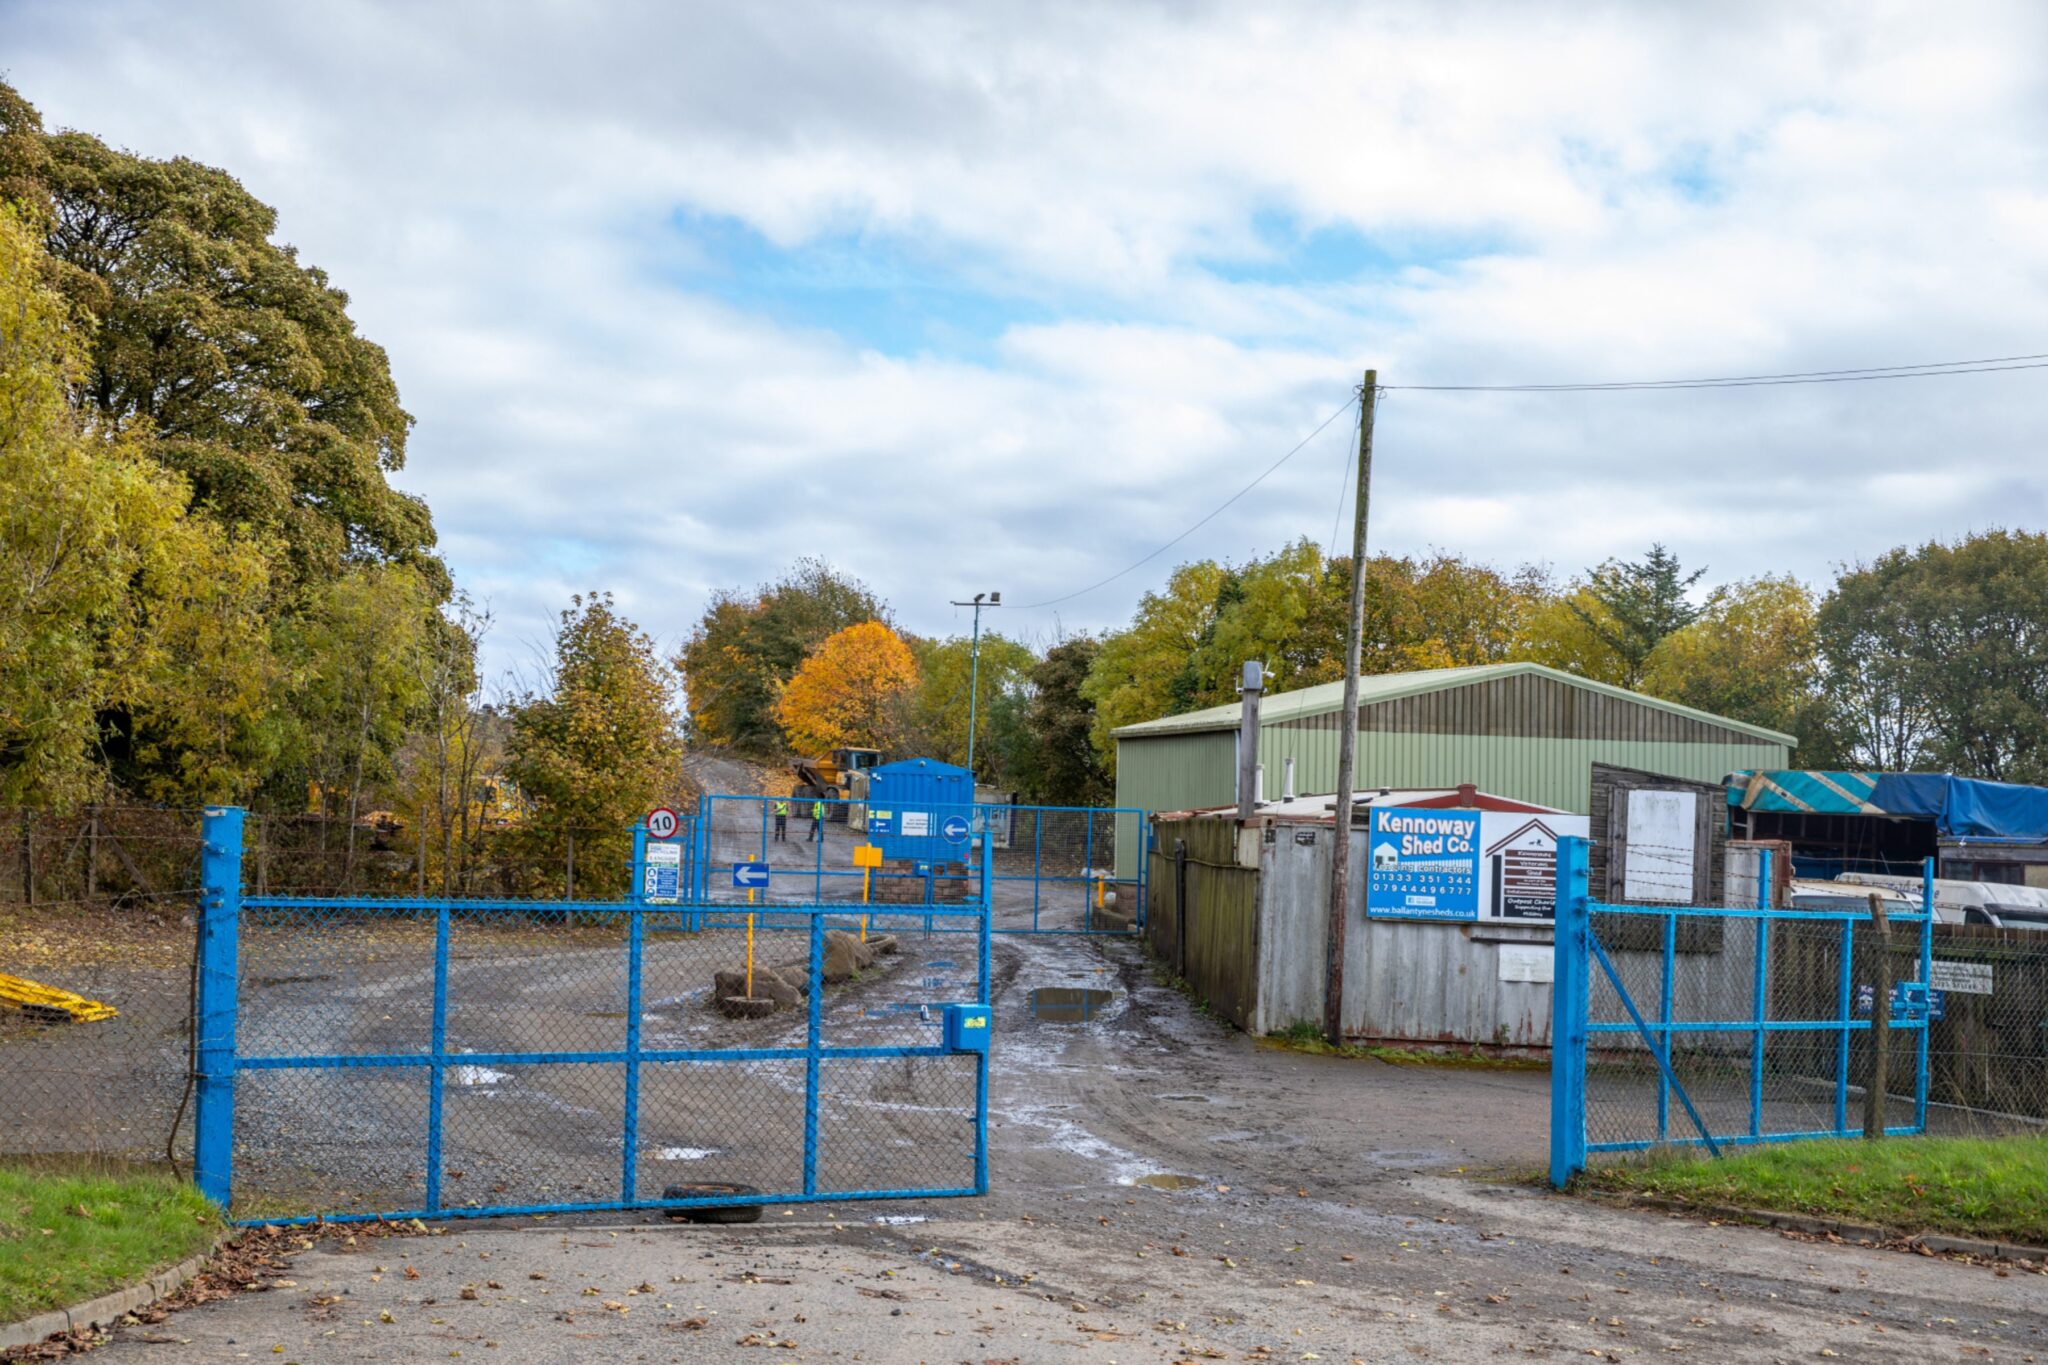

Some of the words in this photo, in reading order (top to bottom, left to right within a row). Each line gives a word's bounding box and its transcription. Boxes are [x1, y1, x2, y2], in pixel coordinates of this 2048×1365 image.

[653, 816, 672, 831] 10
[1377, 812, 1475, 839] Kennoway
[1401, 834, 1443, 855] Shed
[1447, 836, 1474, 853] Co.
[1373, 873, 1411, 881] 01333
[1419, 875, 1440, 883] 351
[1448, 876, 1471, 884] 344
[1370, 906, 1476, 918] www.ballantynesheds.co.uk
